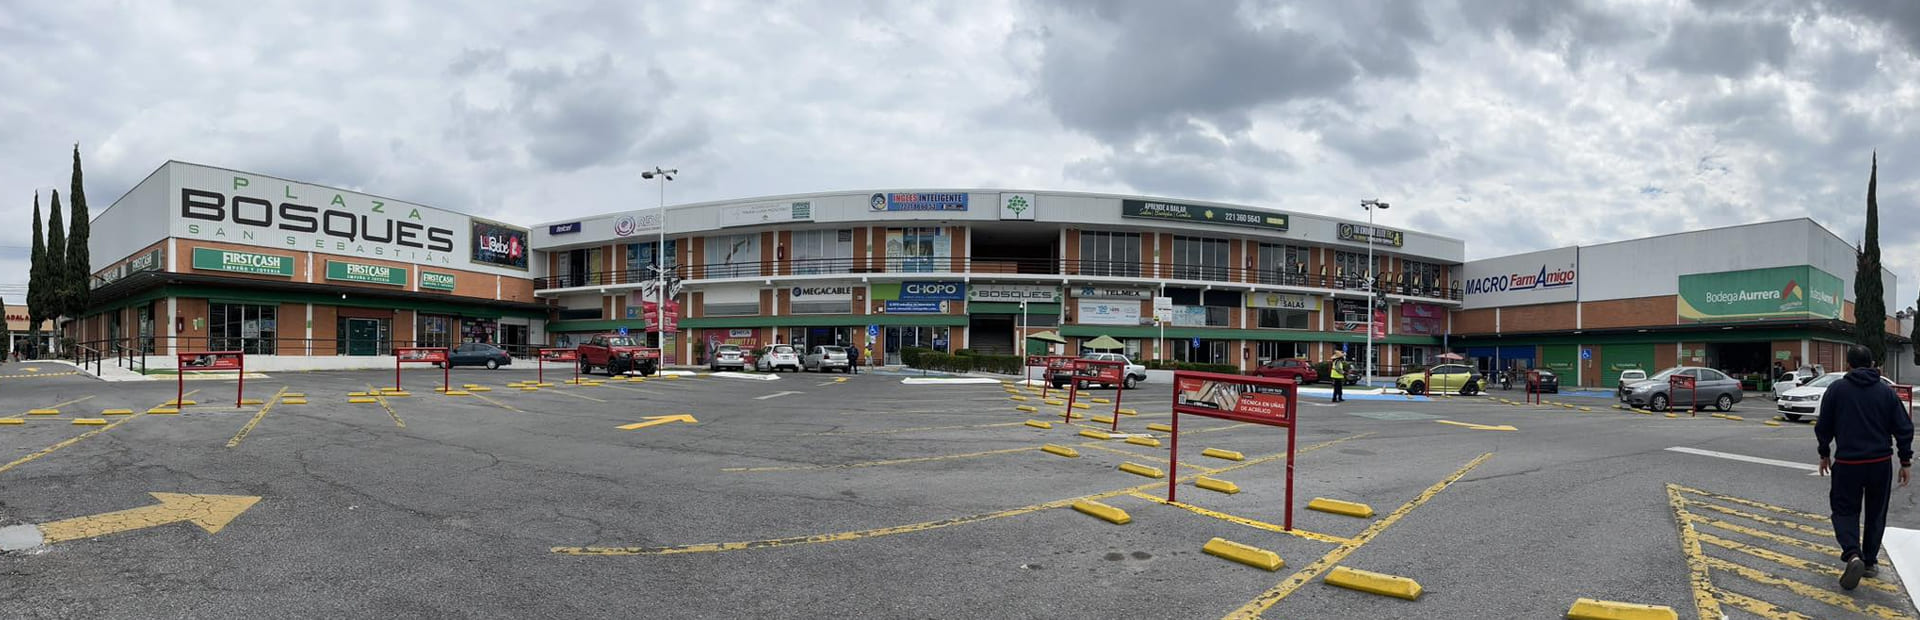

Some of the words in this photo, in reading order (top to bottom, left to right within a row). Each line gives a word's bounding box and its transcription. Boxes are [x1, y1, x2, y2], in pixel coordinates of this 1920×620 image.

[233, 176, 421, 220] PLAZA
[920, 193, 963, 202] INTELIGENTE
[182, 188, 453, 253] BOSQUES
[1225, 212, 1236, 221] 221
[1236, 213, 1247, 222] 360
[188, 224, 254, 240] SAN
[286, 236, 449, 264] SEBASTIÁN
[906, 284, 957, 294] CHOPO
[1465, 275, 1508, 295] MACRO
[802, 286, 851, 296] MEGACABLE
[979, 290, 1052, 299] BOSQUES
[1104, 289, 1141, 297] TELMEX
[1706, 291, 1738, 305] Bodega
[1738, 289, 1780, 301] Aurrera
[1283, 300, 1304, 308] SALAS
[1270, 401, 1285, 409] UÑAS
